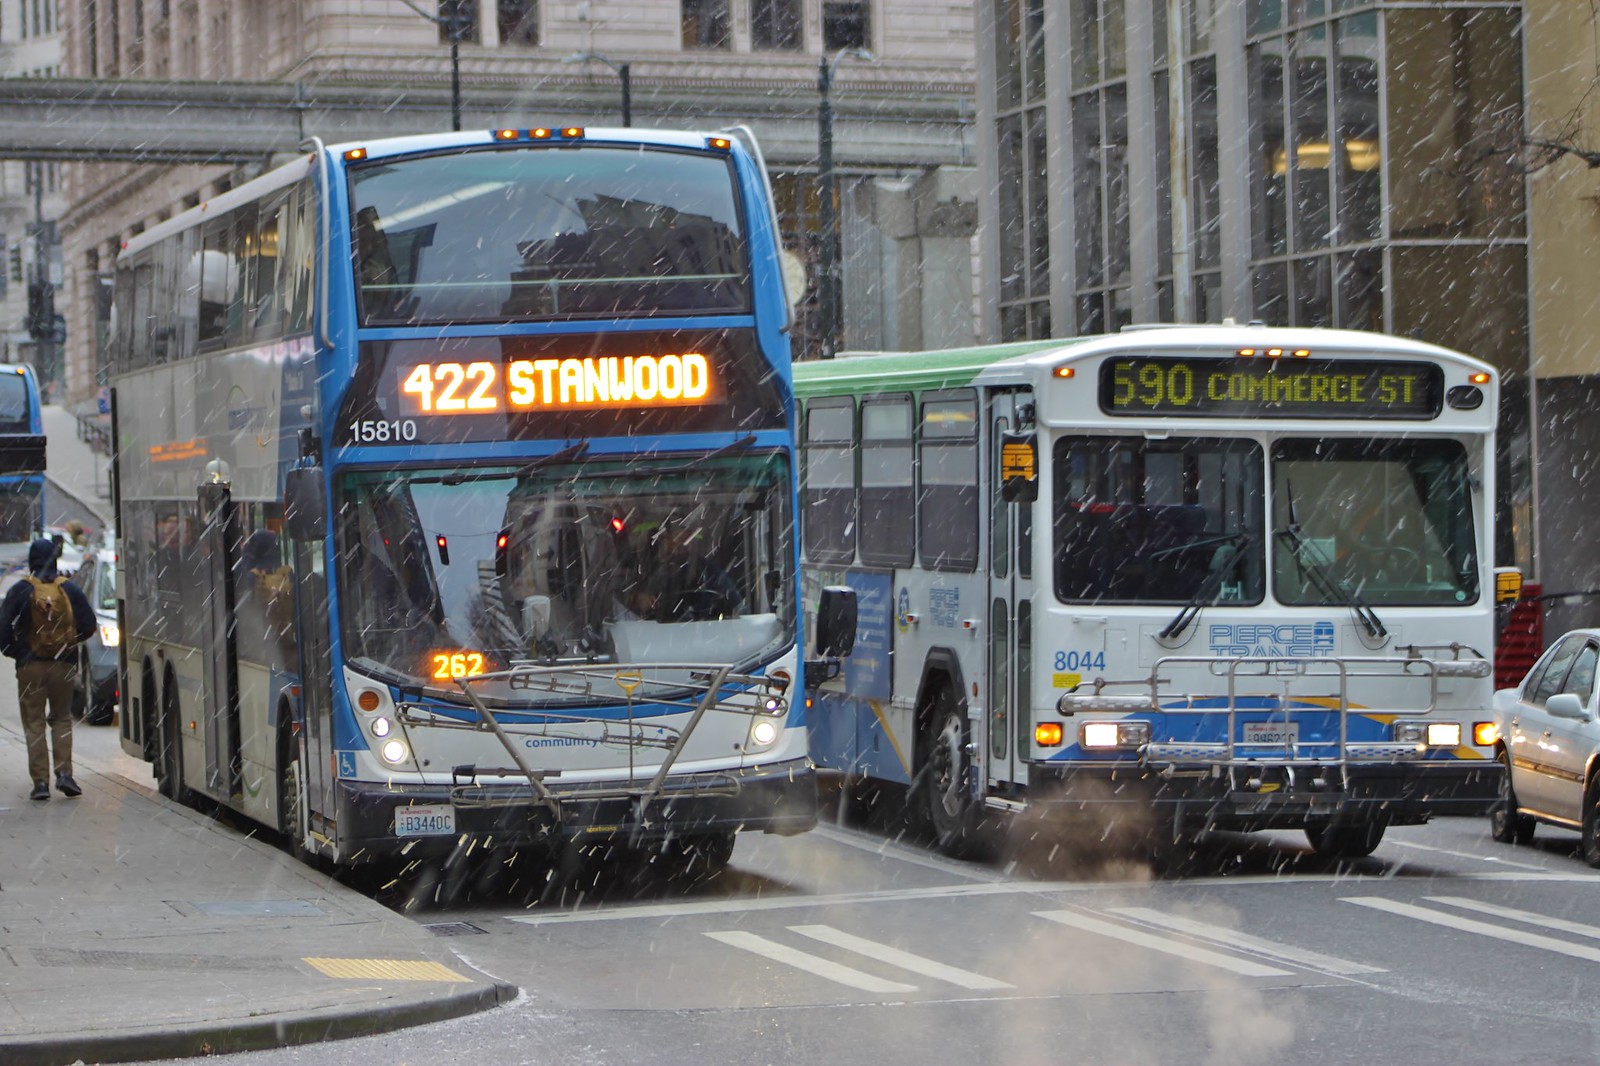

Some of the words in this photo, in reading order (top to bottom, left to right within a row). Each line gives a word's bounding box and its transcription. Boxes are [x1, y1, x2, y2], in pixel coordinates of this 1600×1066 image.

[404, 361, 497, 411] 422
[509, 353, 708, 405] STANWOOD
[1113, 363, 1193, 406] 590
[1207, 373, 1367, 403] COMMERCE
[1378, 375, 1417, 403] ST
[349, 419, 417, 442] 15810
[1209, 624, 1313, 645] PIERCE
[1054, 651, 1106, 671] 8044
[1209, 645, 1335, 664] TRANSIT
[433, 653, 484, 679] 262
[525, 735, 598, 748] community
